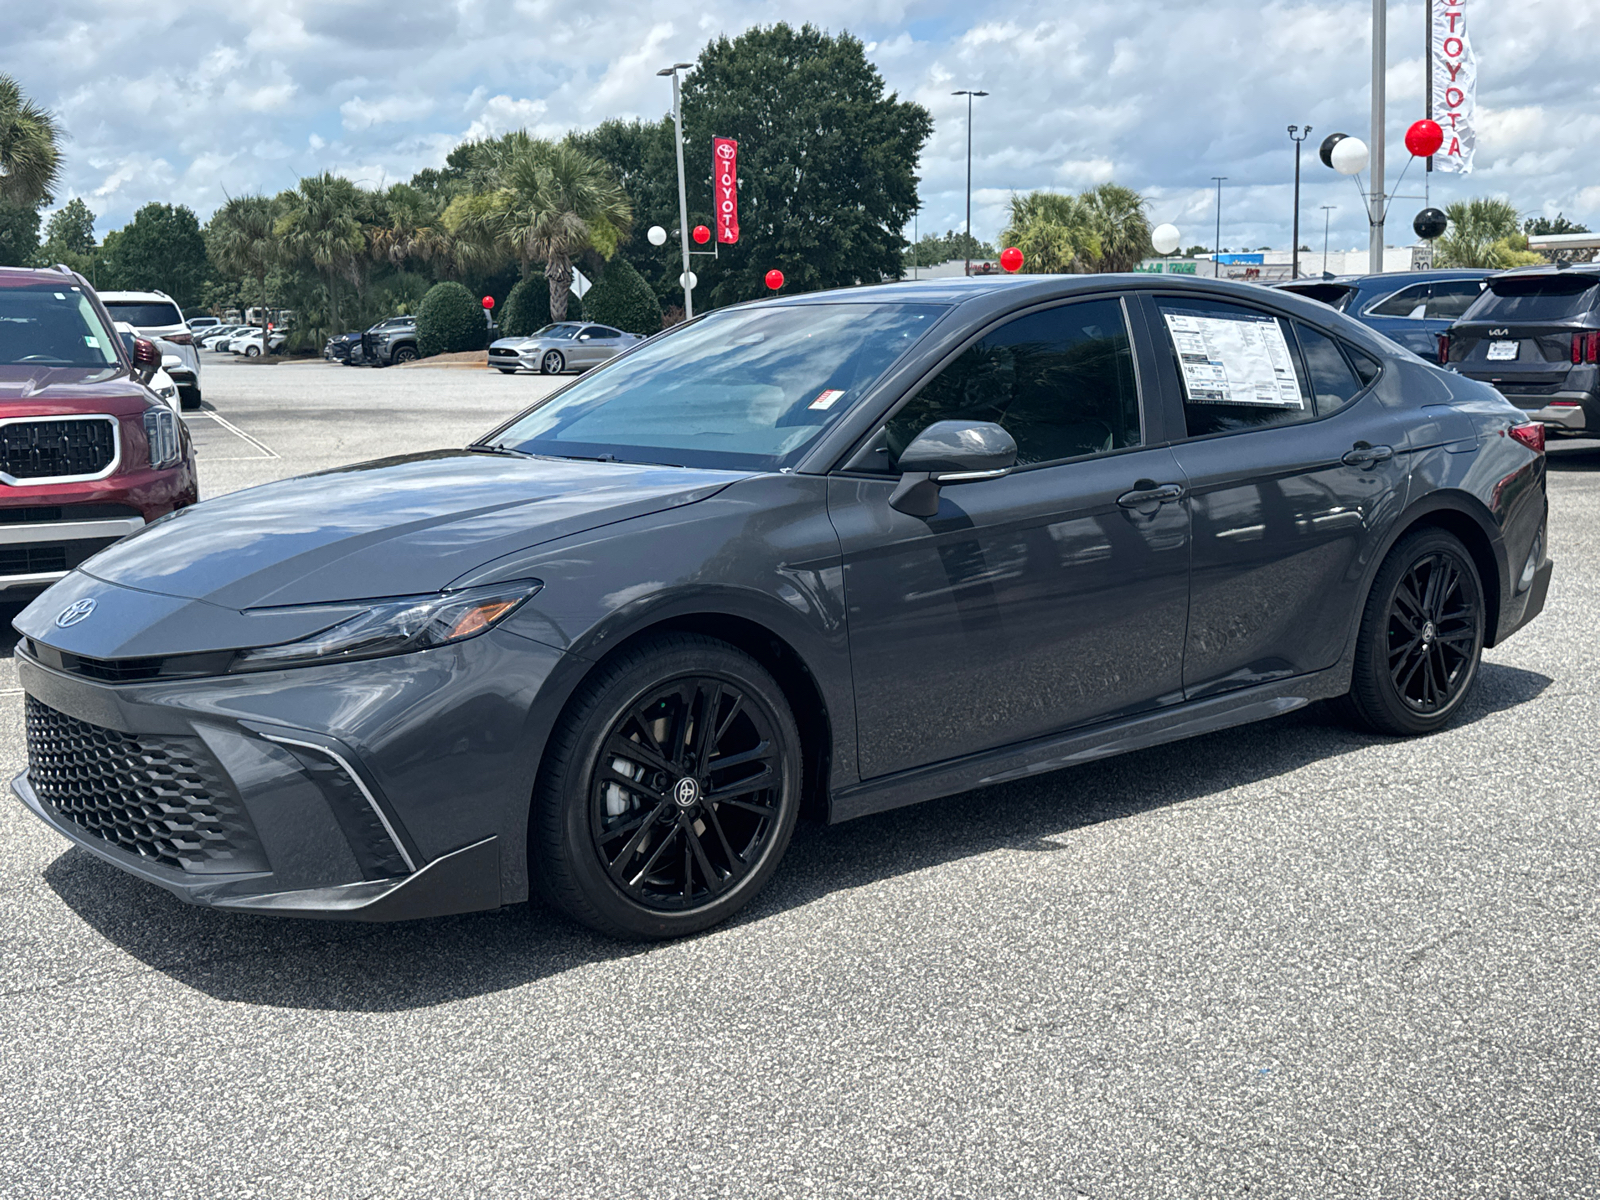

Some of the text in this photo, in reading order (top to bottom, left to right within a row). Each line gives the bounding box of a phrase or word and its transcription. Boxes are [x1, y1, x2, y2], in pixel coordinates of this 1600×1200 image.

[1443, 12, 1464, 157] TOYOTA
[721, 160, 734, 239] TOYOTA
[1169, 262, 1197, 274] TREE
[1414, 262, 1430, 271] 30
